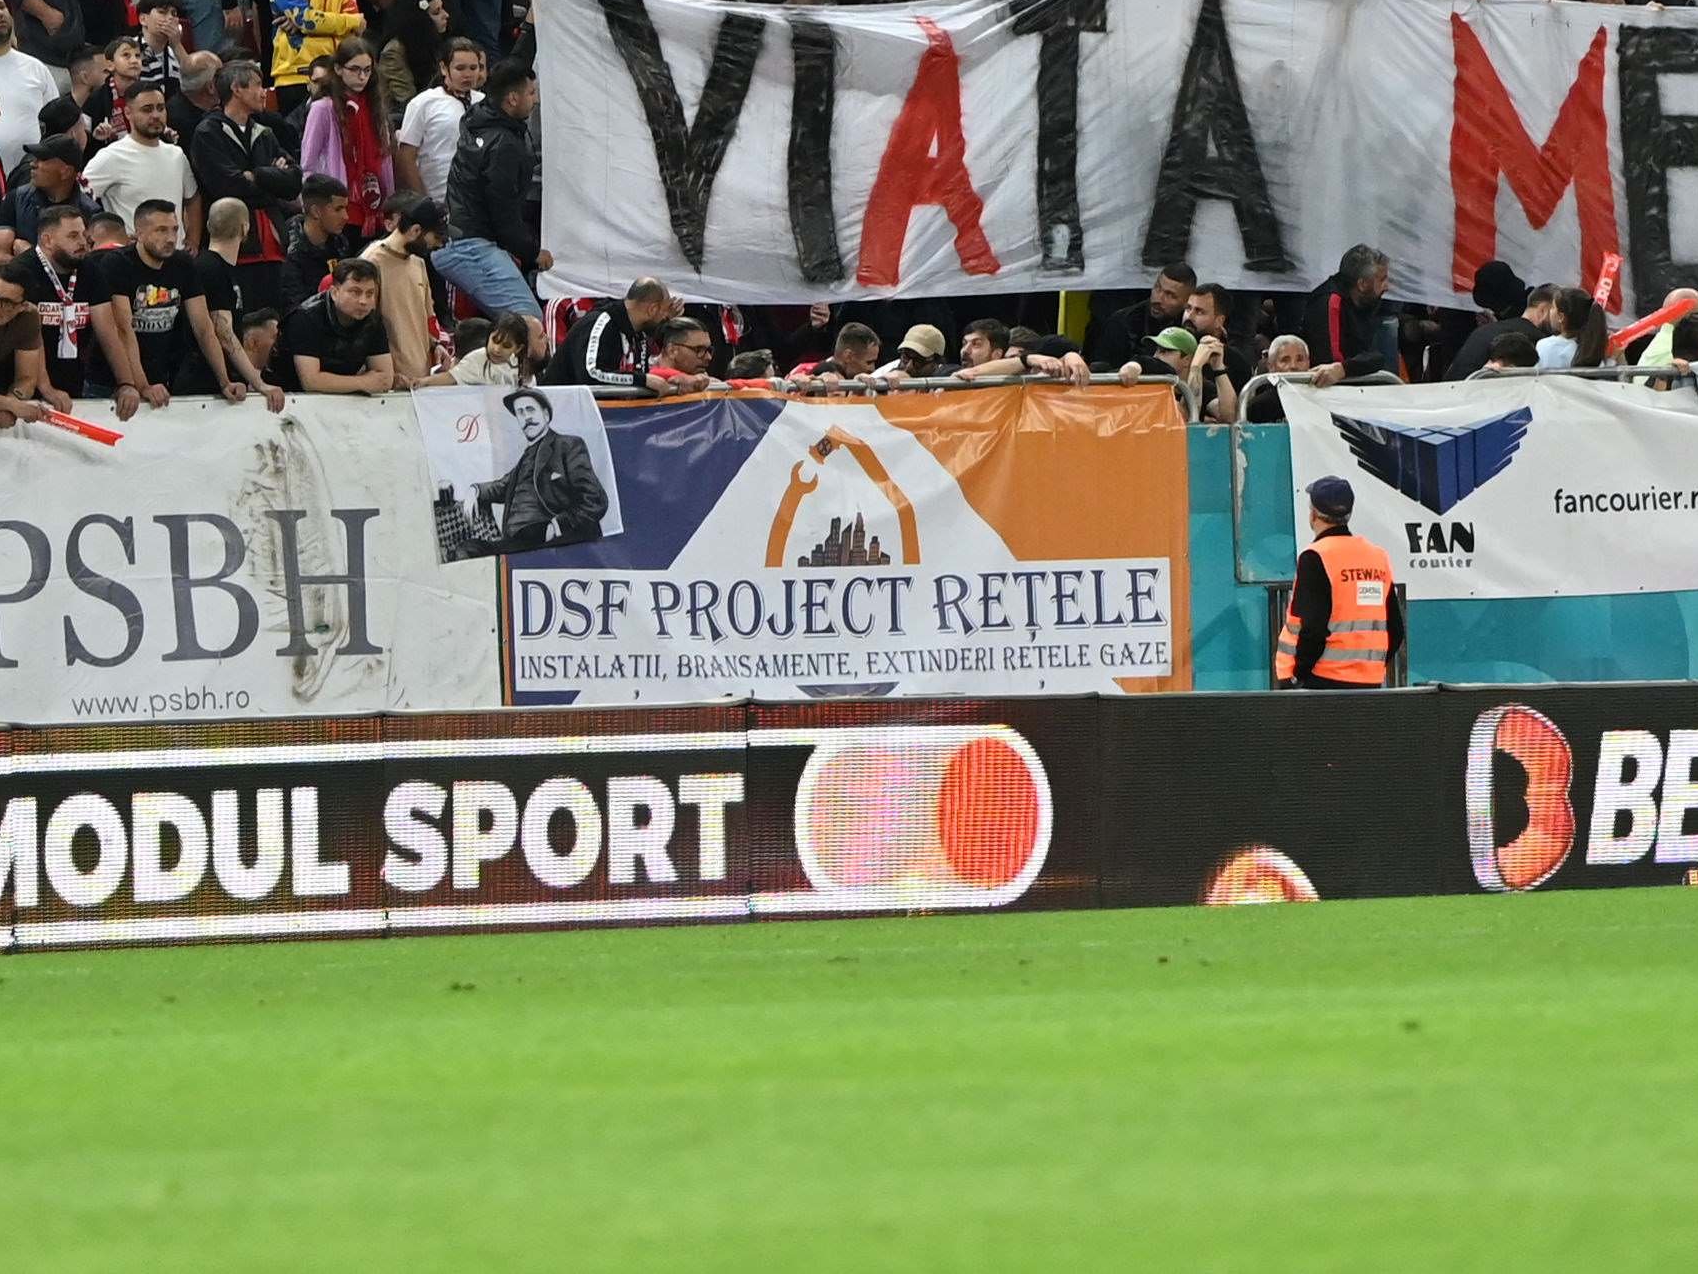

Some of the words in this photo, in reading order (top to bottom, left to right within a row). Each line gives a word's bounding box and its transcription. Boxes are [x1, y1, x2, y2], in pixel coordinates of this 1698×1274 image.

[1404, 521, 1476, 554] FAN
[1409, 556, 1474, 569] courier
[518, 578, 633, 643] DSF
[649, 574, 914, 642] PROJECT
[865, 647, 995, 676] EXTINDERI
[1099, 640, 1171, 667] GAZE
[71, 689, 251, 719] www.psbh.ro
[382, 770, 745, 894] SPORT
